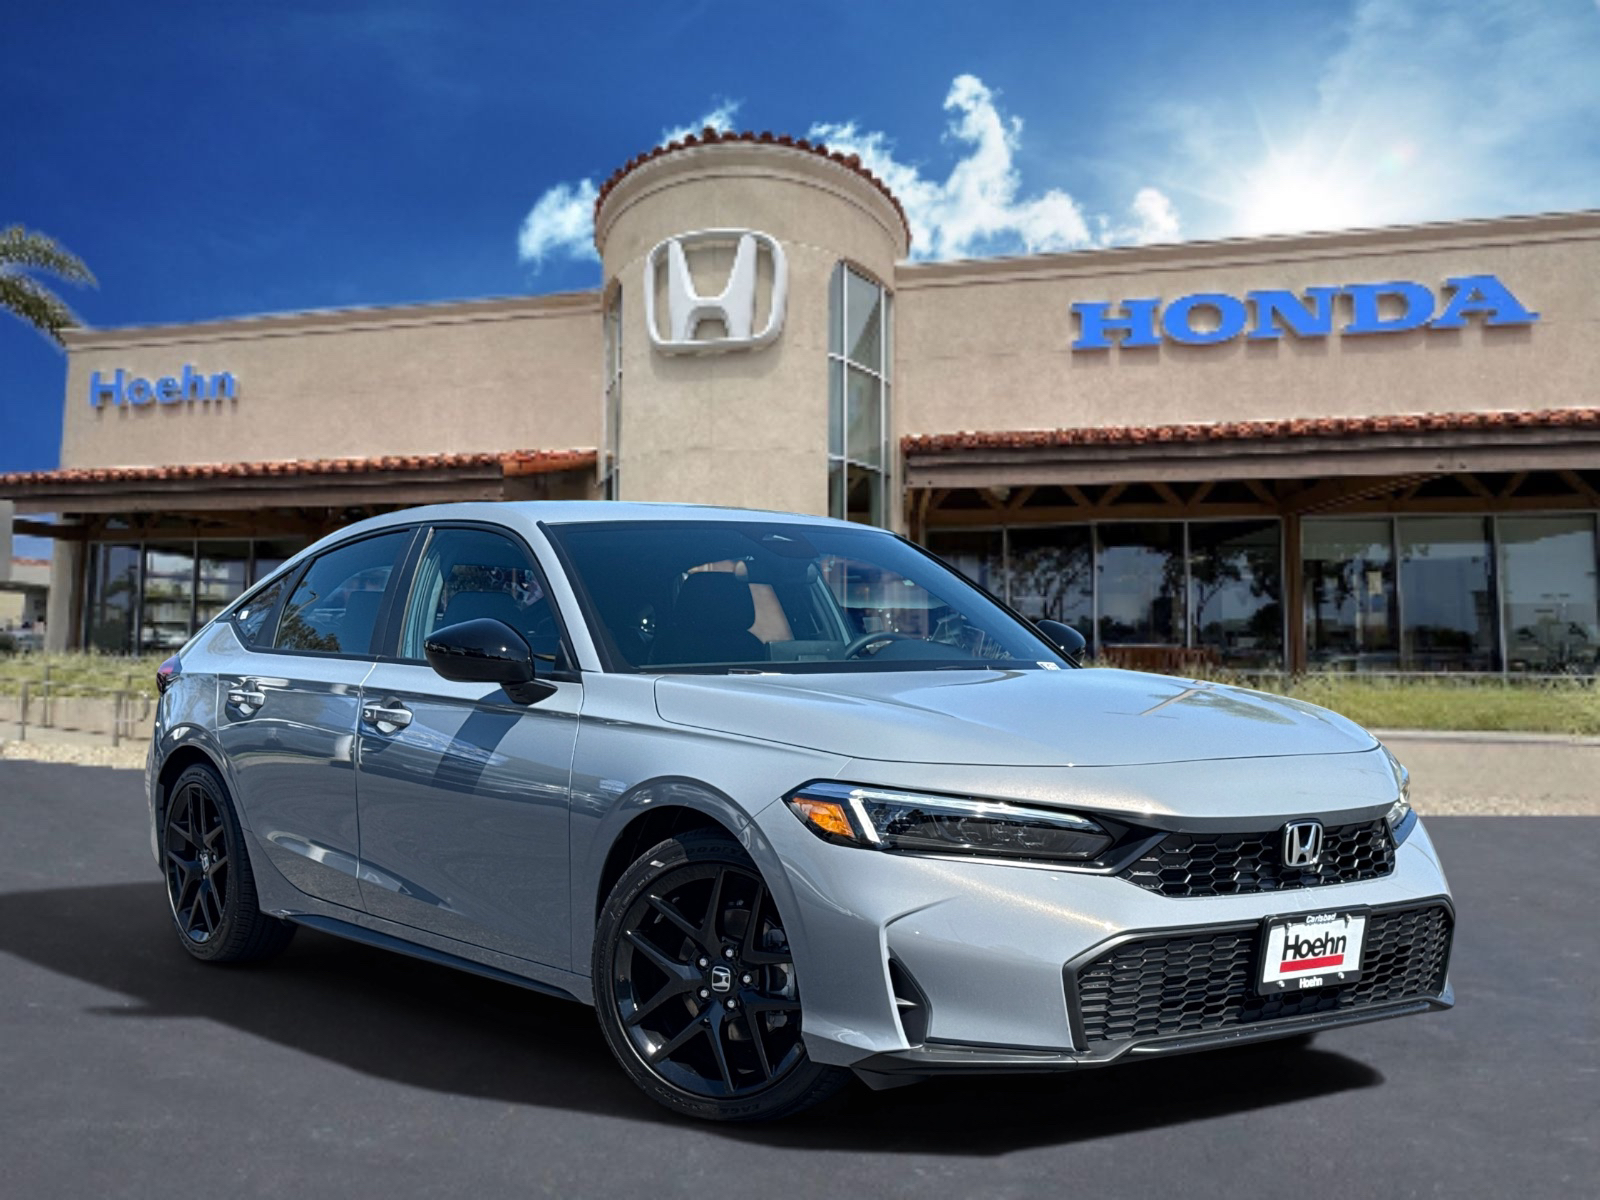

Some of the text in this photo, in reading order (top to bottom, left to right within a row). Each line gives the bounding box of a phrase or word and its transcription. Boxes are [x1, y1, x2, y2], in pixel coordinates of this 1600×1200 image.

[1071, 274, 1541, 350] HONDA
[89, 363, 237, 407] Hoehn
[1306, 912, 1337, 924] Carlsbad
[1282, 931, 1347, 961] Hoehn
[1299, 976, 1323, 989] Hoehn
